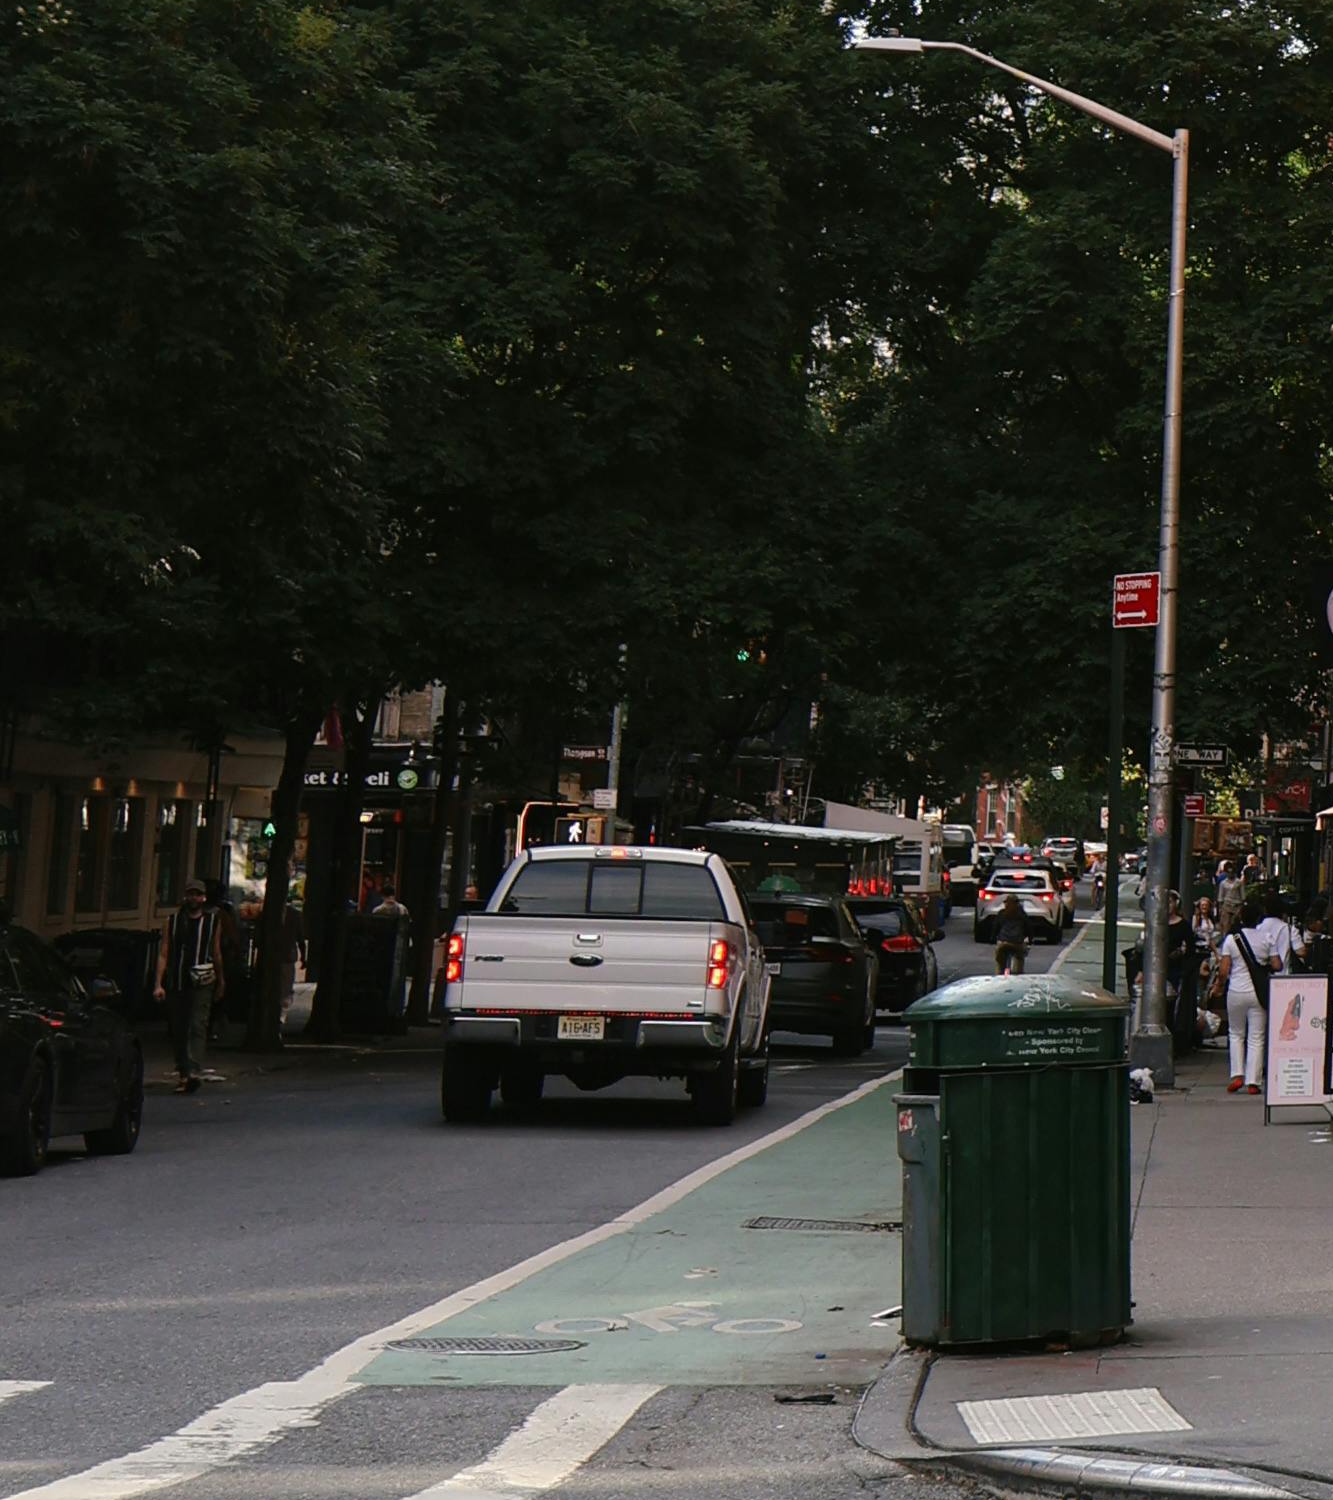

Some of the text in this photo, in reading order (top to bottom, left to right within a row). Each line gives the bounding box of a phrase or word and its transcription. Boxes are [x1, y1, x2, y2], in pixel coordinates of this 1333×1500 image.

[1115, 578, 1152, 590] NO STOPPING
[1116, 591, 1139, 603] Anytime
[1200, 750, 1218, 759] WAY
[364, 770, 391, 786] eli
[1066, 1027, 1081, 1036] City
[1031, 1037, 1074, 1046] Sponsored
[1039, 1047, 1058, 1055] York
[1059, 1046, 1075, 1056] City
